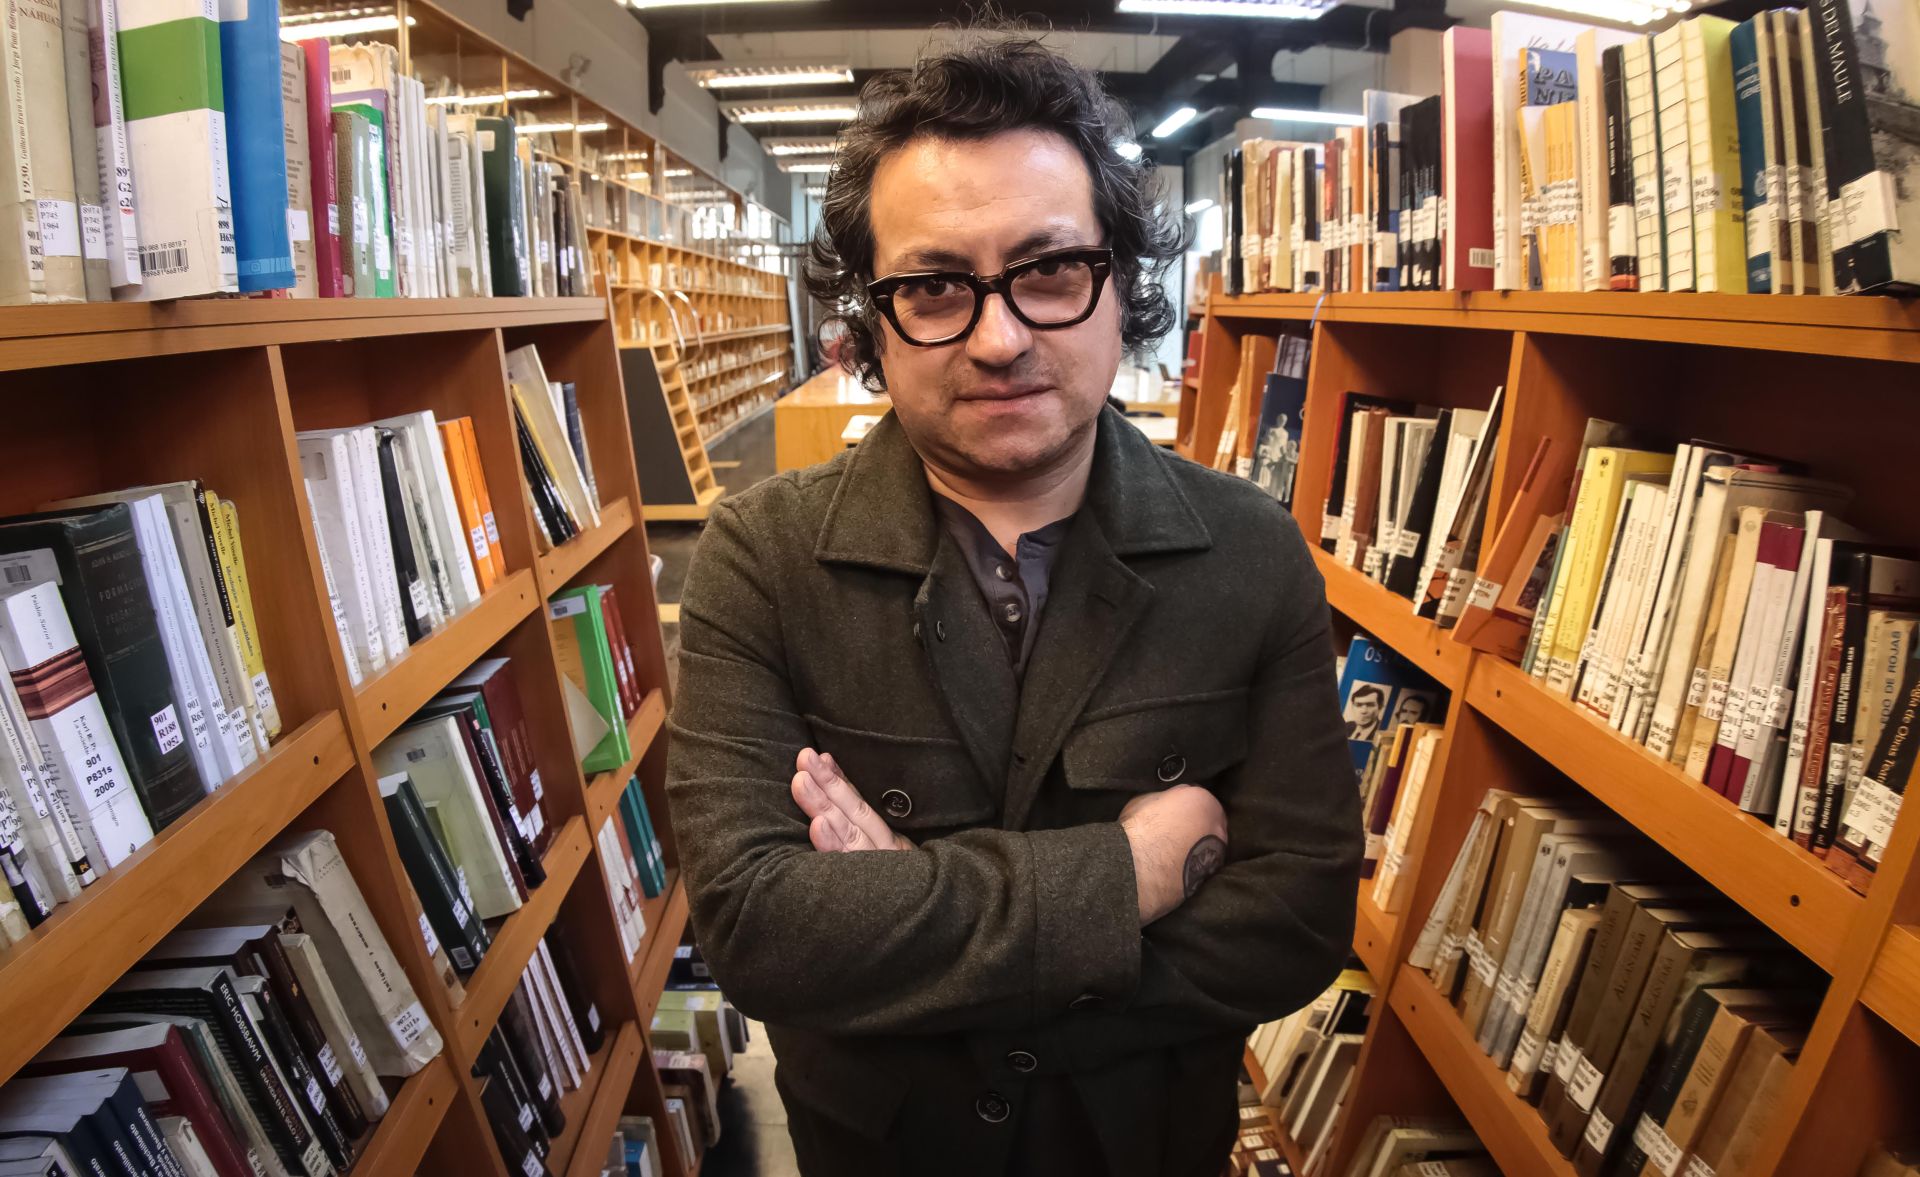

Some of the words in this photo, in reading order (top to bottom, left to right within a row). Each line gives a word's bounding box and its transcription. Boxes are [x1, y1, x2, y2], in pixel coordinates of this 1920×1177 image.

[1820, 7, 1842, 41] DEL
[1824, 41, 1855, 104] MAULE
[1884, 630, 1905, 673] ROJAS
[1884, 677, 1895, 694] DE
[153, 712, 168, 726] 901
[158, 722, 177, 739] R188
[162, 735, 180, 751] 1952
[1888, 724, 1908, 758] Obras
[85, 753, 102, 768] 901
[86, 765, 113, 785] P831s
[94, 779, 116, 798] 2006
[218, 983, 235, 1006] ERIC
[229, 1006, 262, 1061] HOBSBAWM
[133, 1107, 165, 1148] Bachillerato
[127, 1123, 157, 1166] Bachillerato
